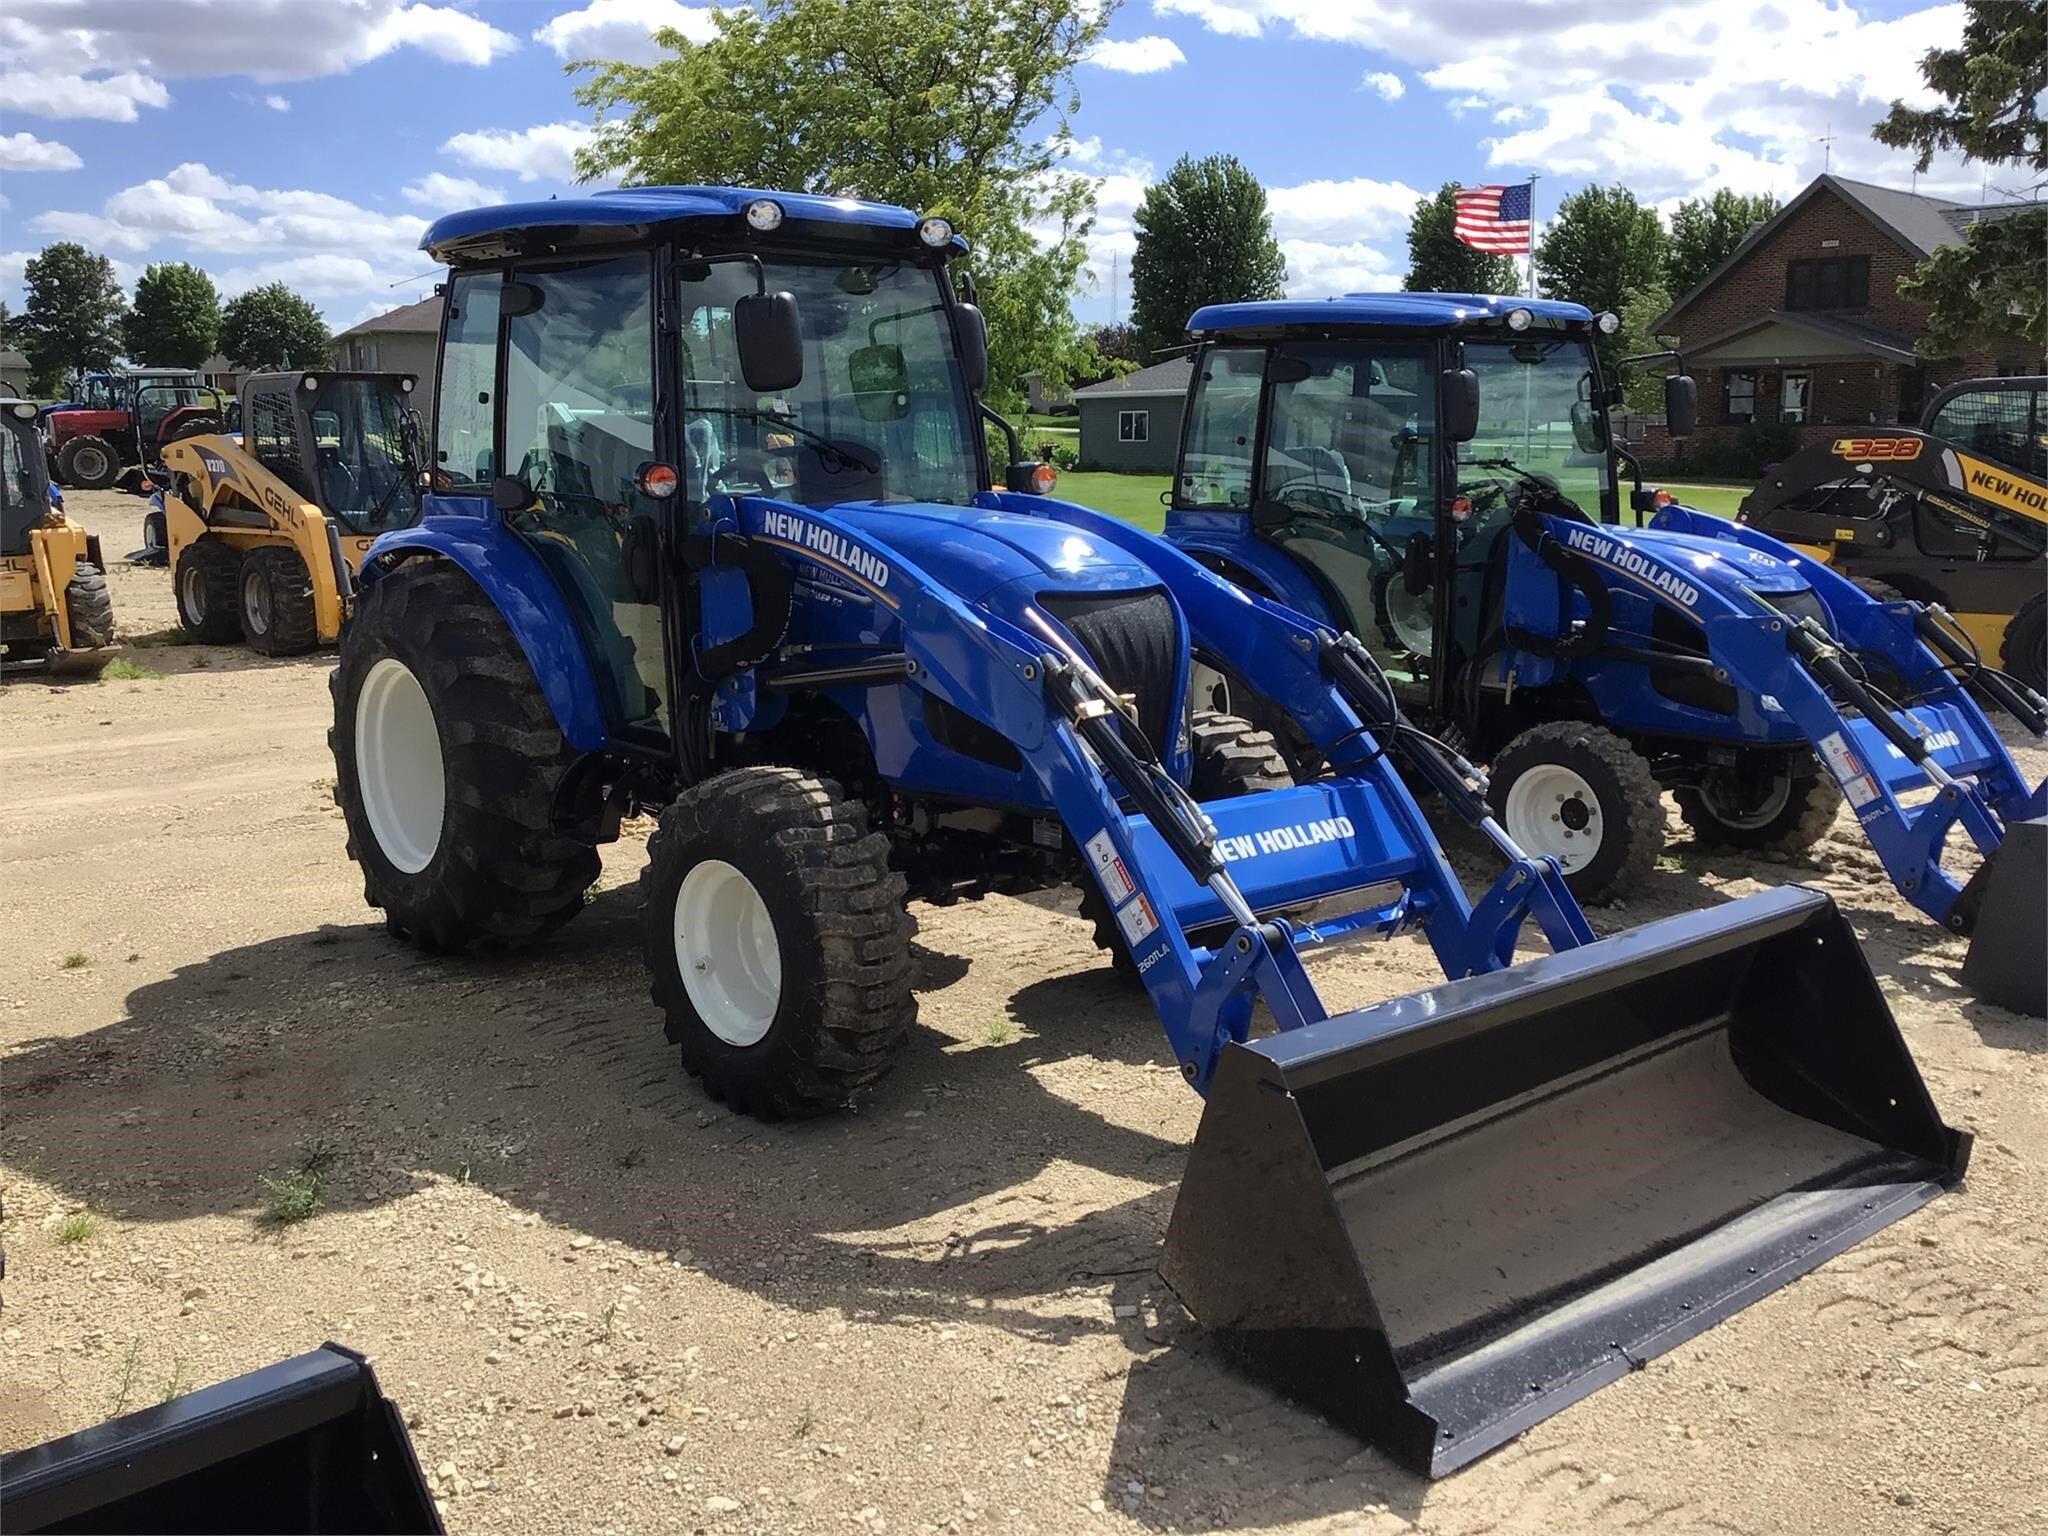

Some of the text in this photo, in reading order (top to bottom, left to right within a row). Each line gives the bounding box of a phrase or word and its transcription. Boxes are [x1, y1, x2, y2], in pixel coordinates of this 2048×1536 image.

[1970, 470, 2013, 496] NEW
[265, 486, 299, 529] GEHL
[764, 510, 889, 588] NEW HOLLAND
[1567, 529, 1699, 607] NEW HOLLAND
[1254, 816, 1356, 855] HOLLAND
[1136, 943, 1171, 974] 260TLA
